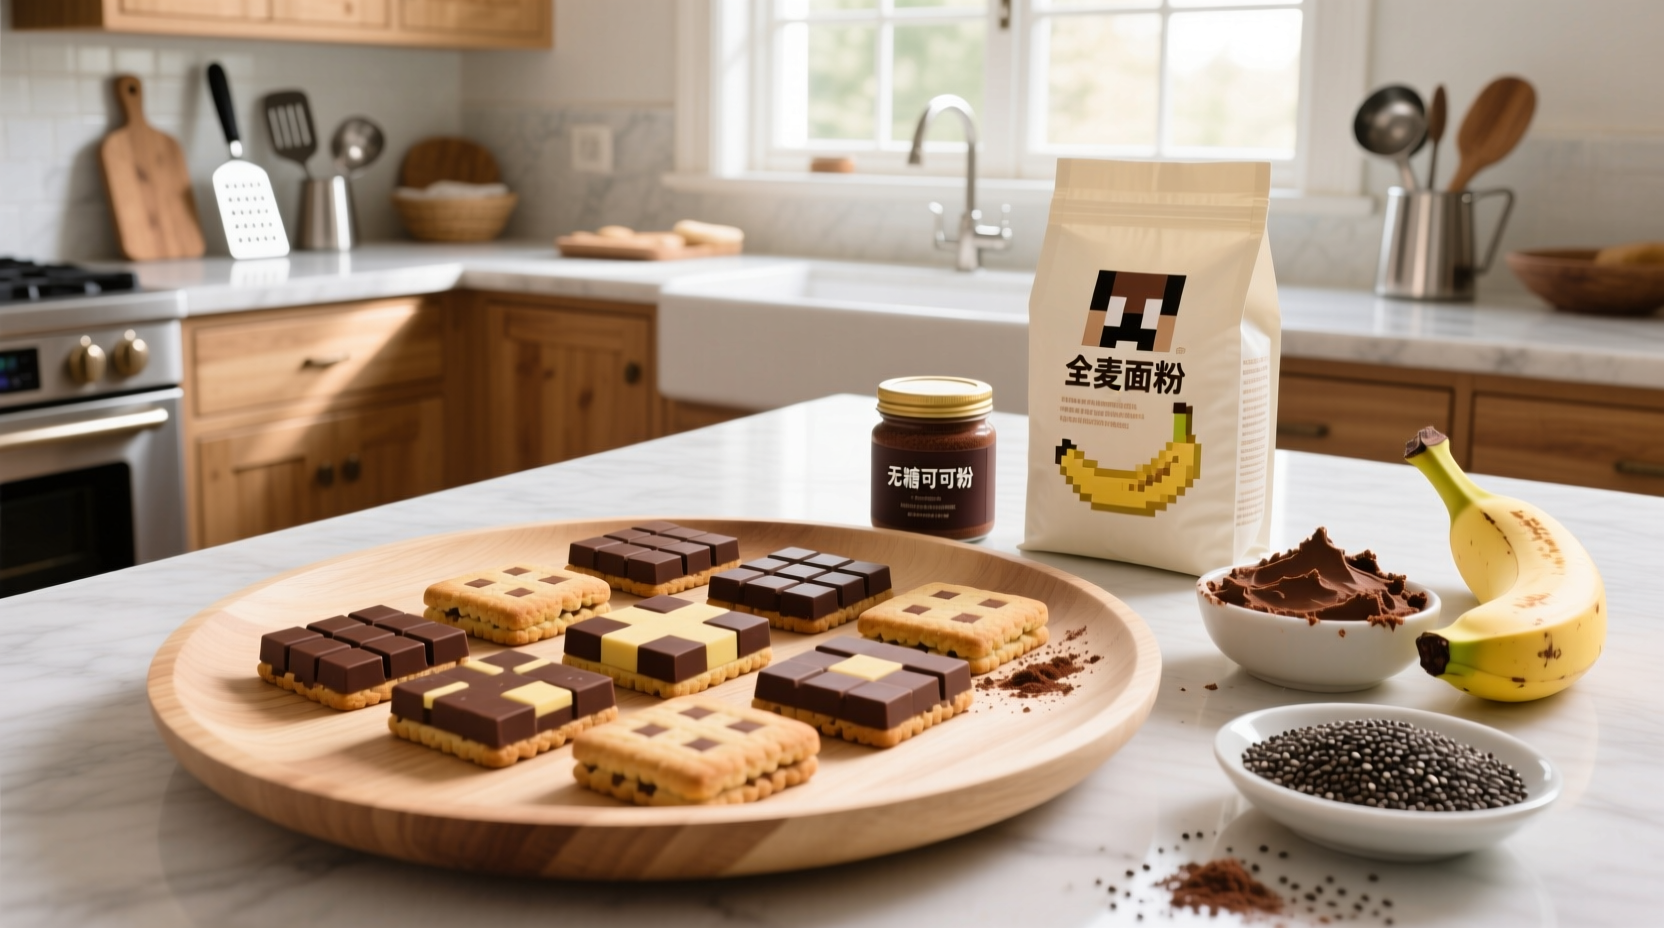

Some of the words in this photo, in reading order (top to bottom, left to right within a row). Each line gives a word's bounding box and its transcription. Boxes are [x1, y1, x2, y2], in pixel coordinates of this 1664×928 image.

[1065, 354, 1185, 395] 全麦面粉
[887, 465, 973, 489] 无糖可可粉
